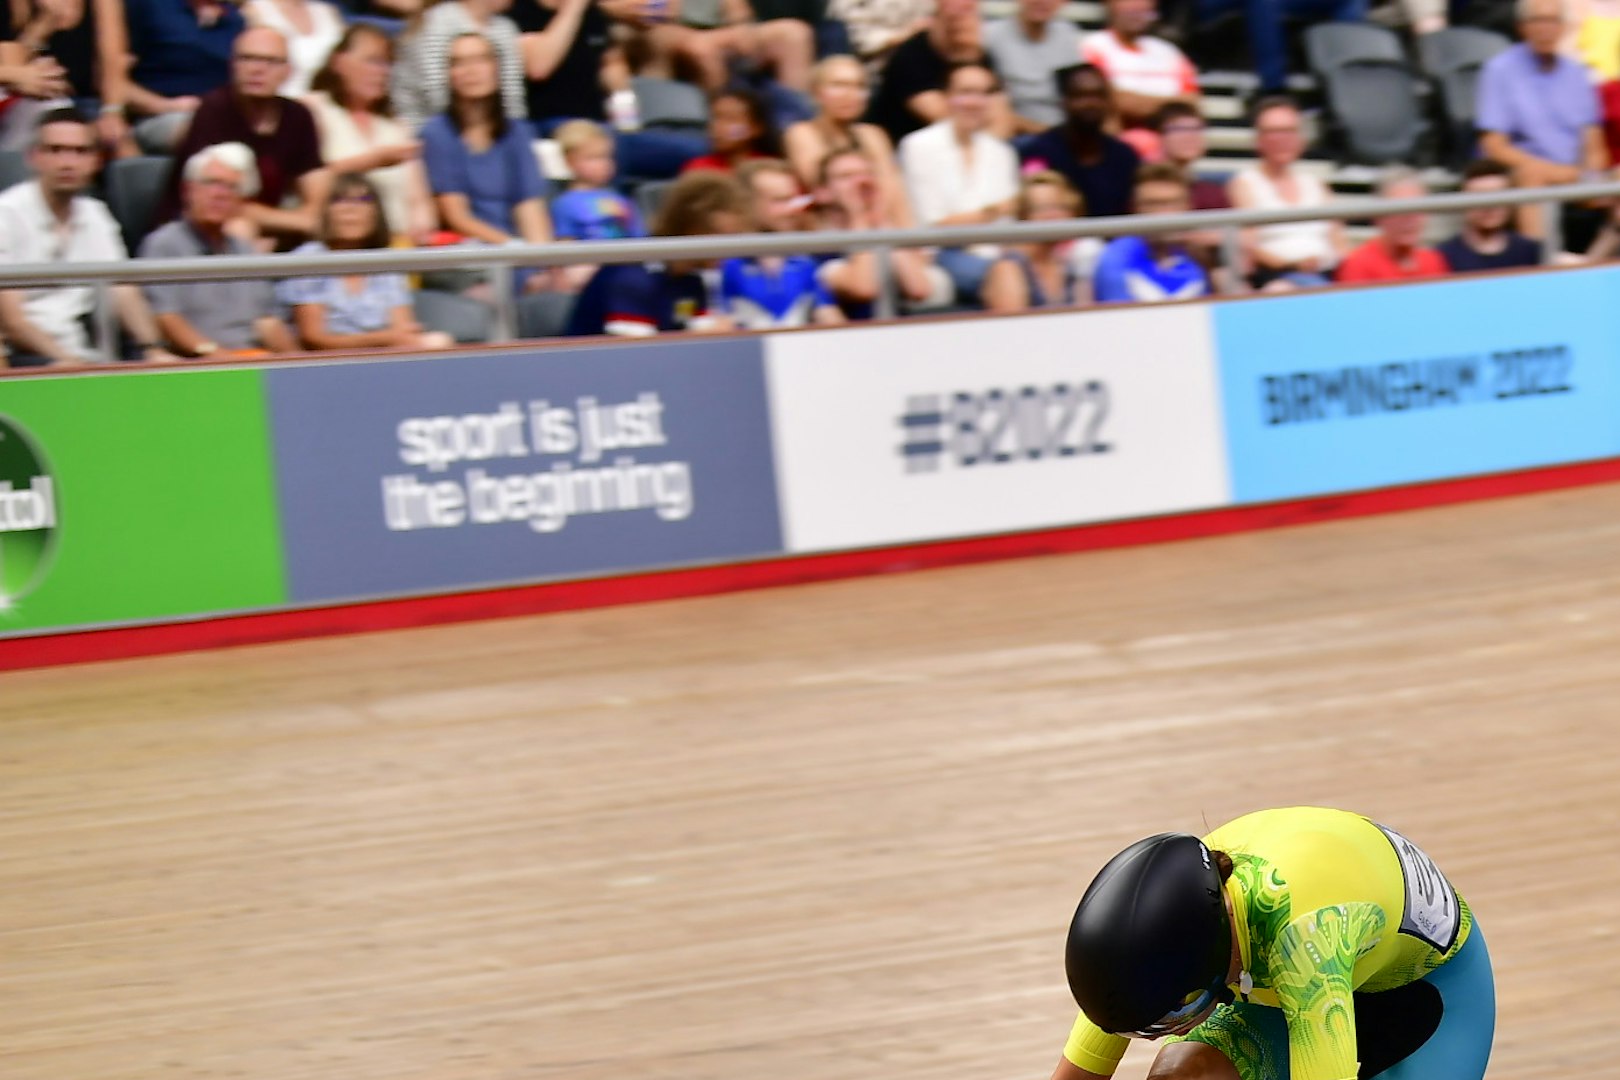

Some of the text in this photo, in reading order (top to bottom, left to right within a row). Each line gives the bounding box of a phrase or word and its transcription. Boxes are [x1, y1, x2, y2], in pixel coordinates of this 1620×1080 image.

[896, 379, 1114, 473] #B2022
[1260, 343, 1574, 428] BIRMINGHAM 2022
[396, 391, 668, 471] sport is just
[381, 456, 694, 533] the beginning
